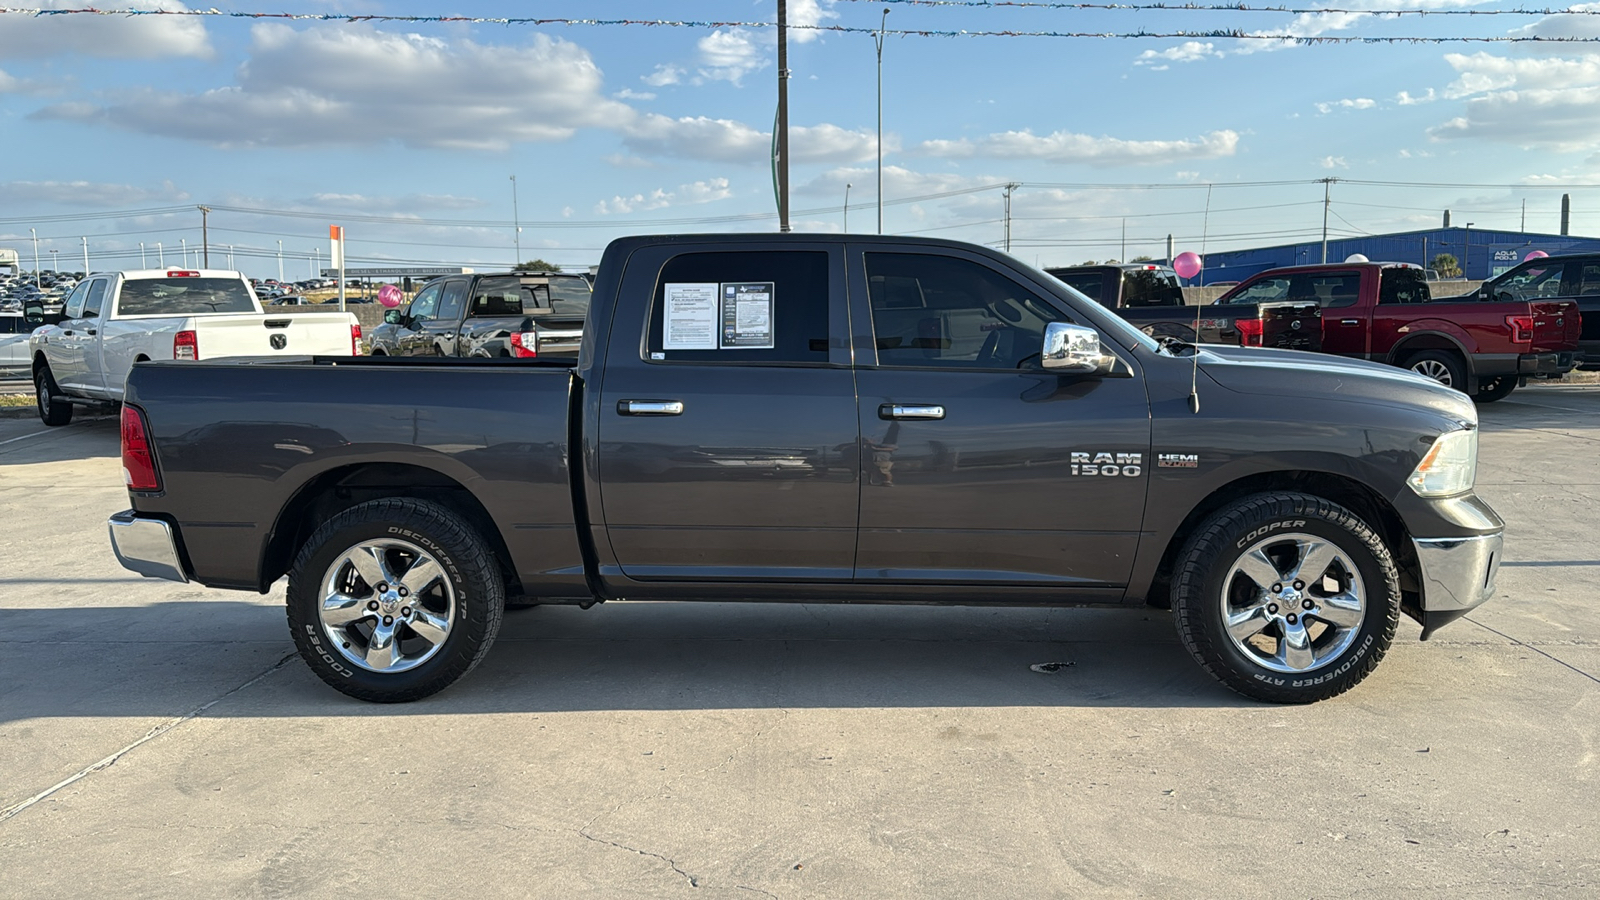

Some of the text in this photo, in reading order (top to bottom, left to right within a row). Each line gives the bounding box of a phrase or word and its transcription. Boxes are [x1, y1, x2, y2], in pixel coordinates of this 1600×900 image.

[1070, 451, 1142, 464] RAM
[1070, 464, 1142, 477] 1500
[1158, 453, 1198, 461] HEMI
[1236, 520, 1306, 549] COOPER
[387, 526, 468, 620] DISCOVERER ATP
[305, 624, 354, 678] COOPER
[1253, 633, 1374, 688] DISCOVERER ATP
